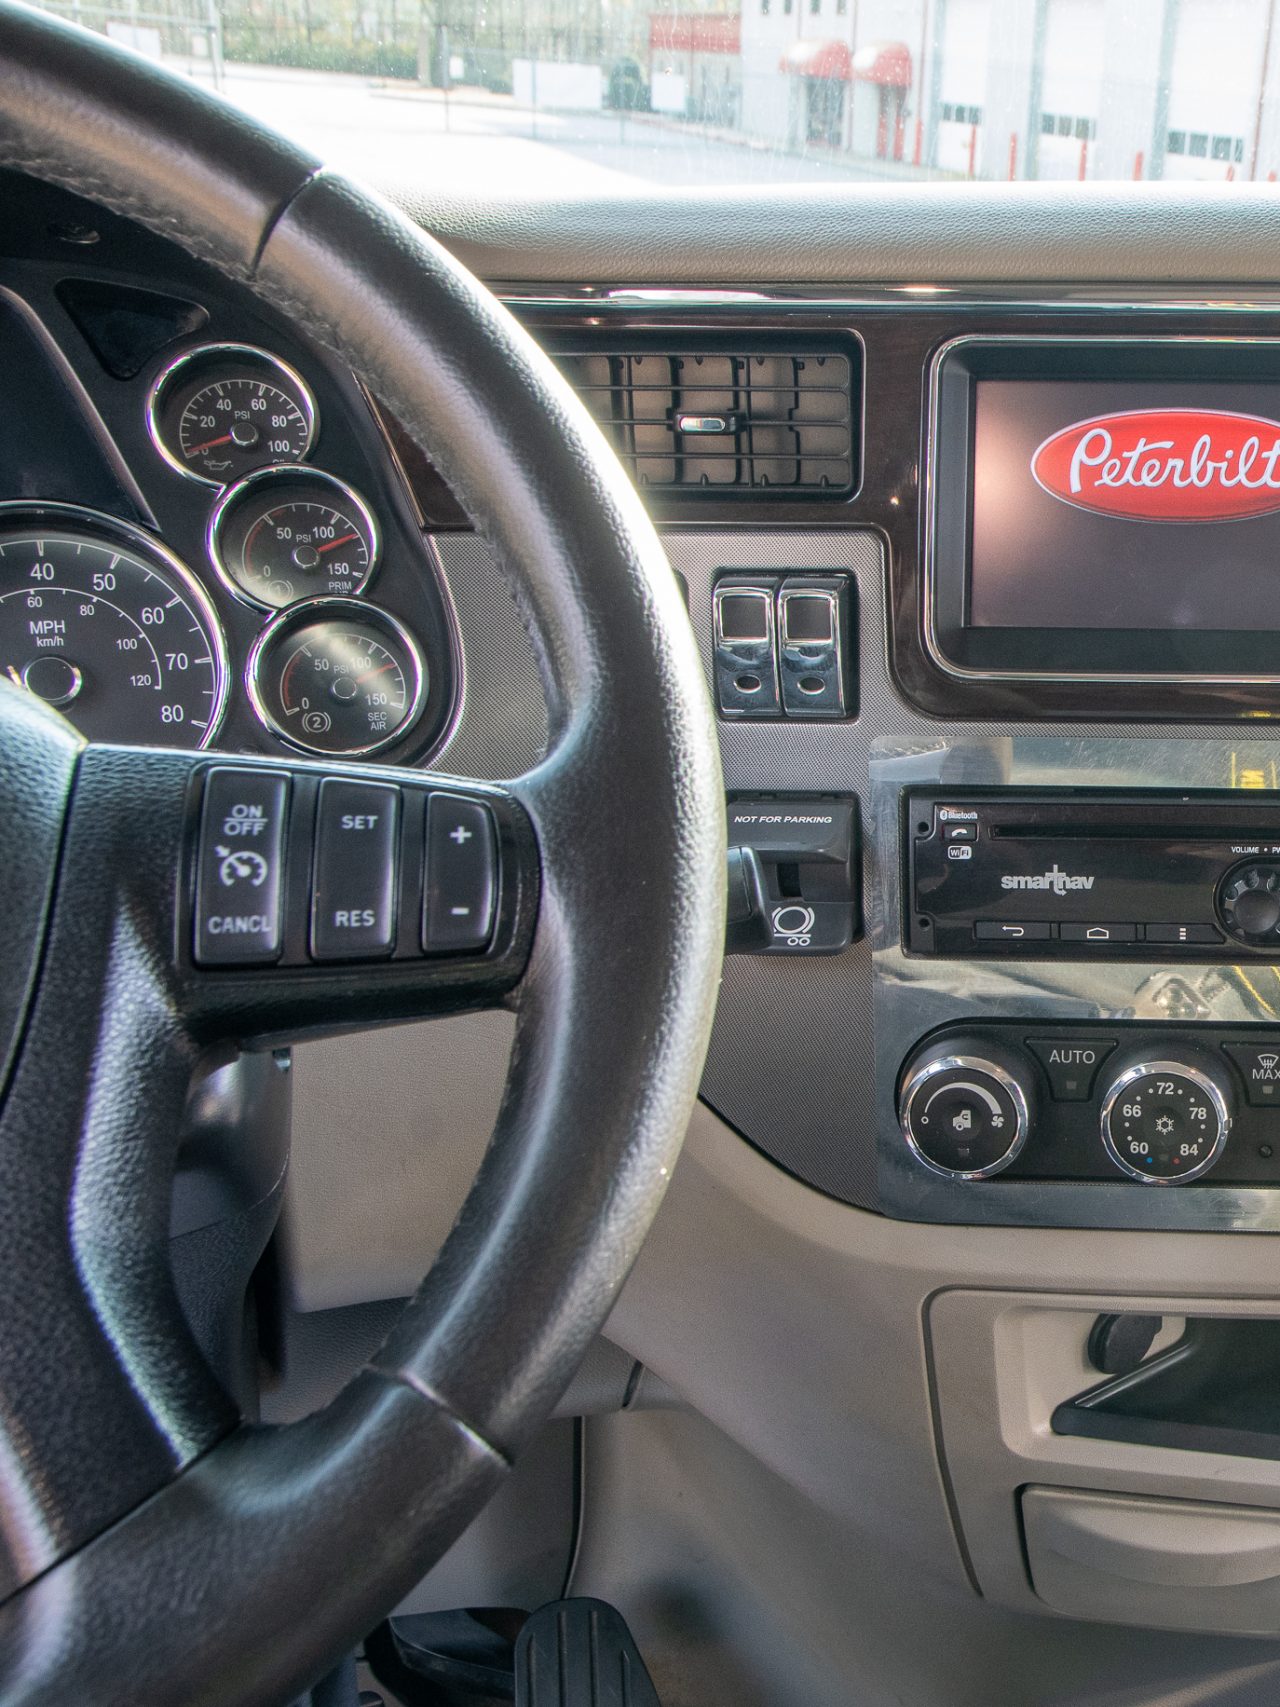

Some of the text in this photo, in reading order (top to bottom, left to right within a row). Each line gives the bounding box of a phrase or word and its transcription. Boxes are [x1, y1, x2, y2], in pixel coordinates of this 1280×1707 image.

[216, 399, 232, 410] 40
[251, 399, 267, 410] 60
[234, 411, 251, 420] PSI
[200, 416, 216, 428] 20
[271, 416, 287, 428] 80
[267, 440, 290, 452] 100
[276, 527, 292, 540] 50
[312, 526, 335, 538] 100
[296, 534, 312, 543] PSI
[30, 563, 55, 581] 40
[263, 565, 271, 577] 0
[327, 562, 350, 575] 150
[92, 573, 117, 591] 50
[328, 581, 352, 591] PRIM
[27, 596, 43, 608] 60
[80, 604, 95, 616] 80
[141, 607, 165, 624] 60
[29, 620, 66, 634] MPH
[36, 636, 65, 648] km/h
[116, 638, 138, 650] 100
[165, 652, 188, 670] 70
[314, 659, 330, 671] 50
[351, 657, 372, 669] 100
[333, 665, 350, 674] PSI
[130, 674, 151, 687] 120
[302, 698, 310, 710] 0
[365, 693, 388, 706] 150
[161, 704, 184, 723] 80
[368, 712, 388, 721] SEC
[370, 722, 386, 730] AIR
[231, 804, 264, 819] ON
[341, 815, 379, 830] SET
[784, 816, 833, 824] PARKING
[223, 822, 266, 836] OFF
[1231, 846, 1260, 854] VOLUME
[1001, 864, 1095, 896] smartnav
[208, 916, 274, 934] CANCL
[334, 910, 375, 928] RES
[1049, 1049, 1096, 1064] AUTO
[1156, 1082, 1174, 1095] 72
[1122, 1104, 1142, 1117] 66
[1189, 1108, 1206, 1120] 78
[1130, 1142, 1149, 1154] 60
[1180, 1144, 1198, 1156] 84
